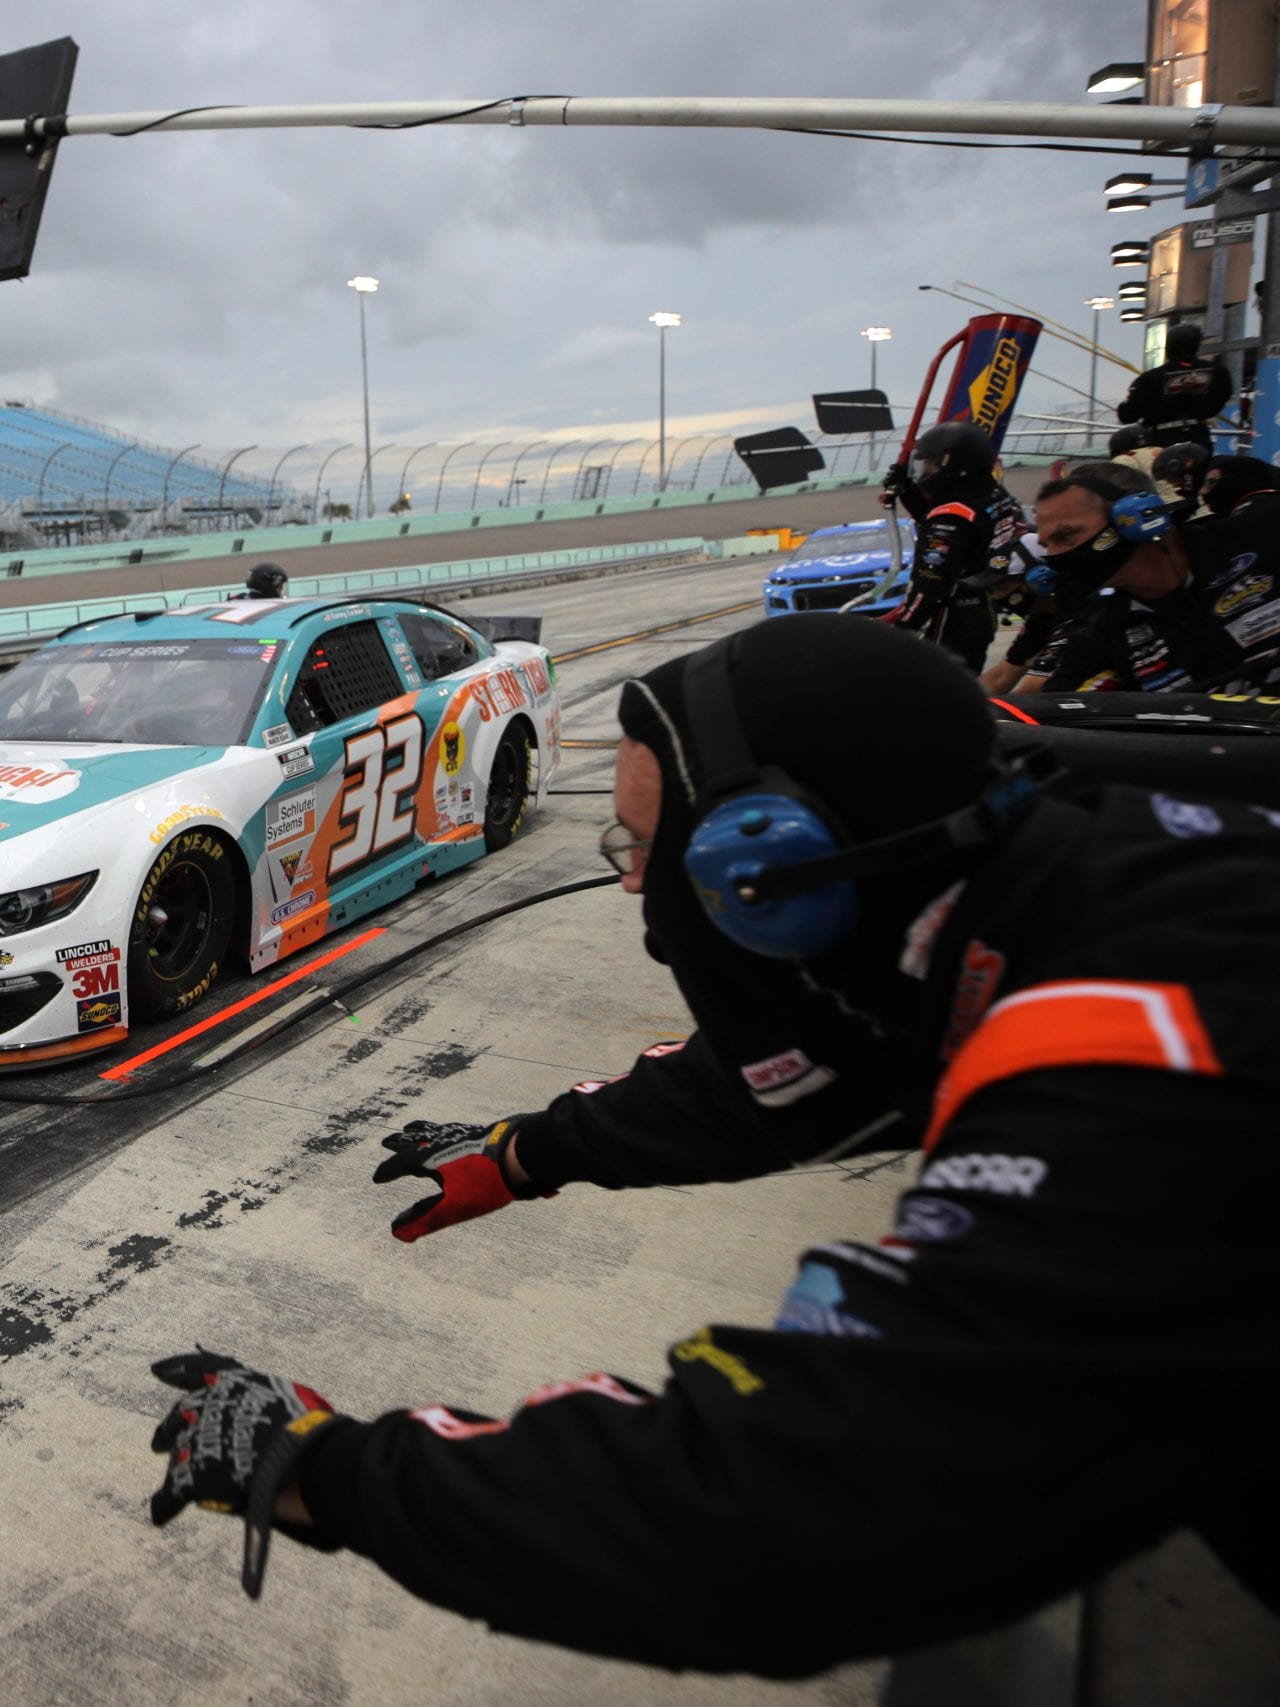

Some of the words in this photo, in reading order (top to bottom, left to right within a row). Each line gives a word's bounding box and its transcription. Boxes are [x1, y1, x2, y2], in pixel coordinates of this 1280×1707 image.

[99, 648, 128, 657] CUP
[129, 645, 189, 656] SERIES
[280, 799, 315, 821] Schluter
[327, 713, 424, 884] 32
[149, 804, 224, 845] GOODYEAR
[267, 816, 303, 841] Systems
[137, 832, 224, 923] GOODYEAR
[58, 942, 109, 962] LINCOLN
[70, 953, 115, 969] WELDERS
[72, 963, 120, 999] 3M
[80, 1002, 120, 1023] SUNOCO
